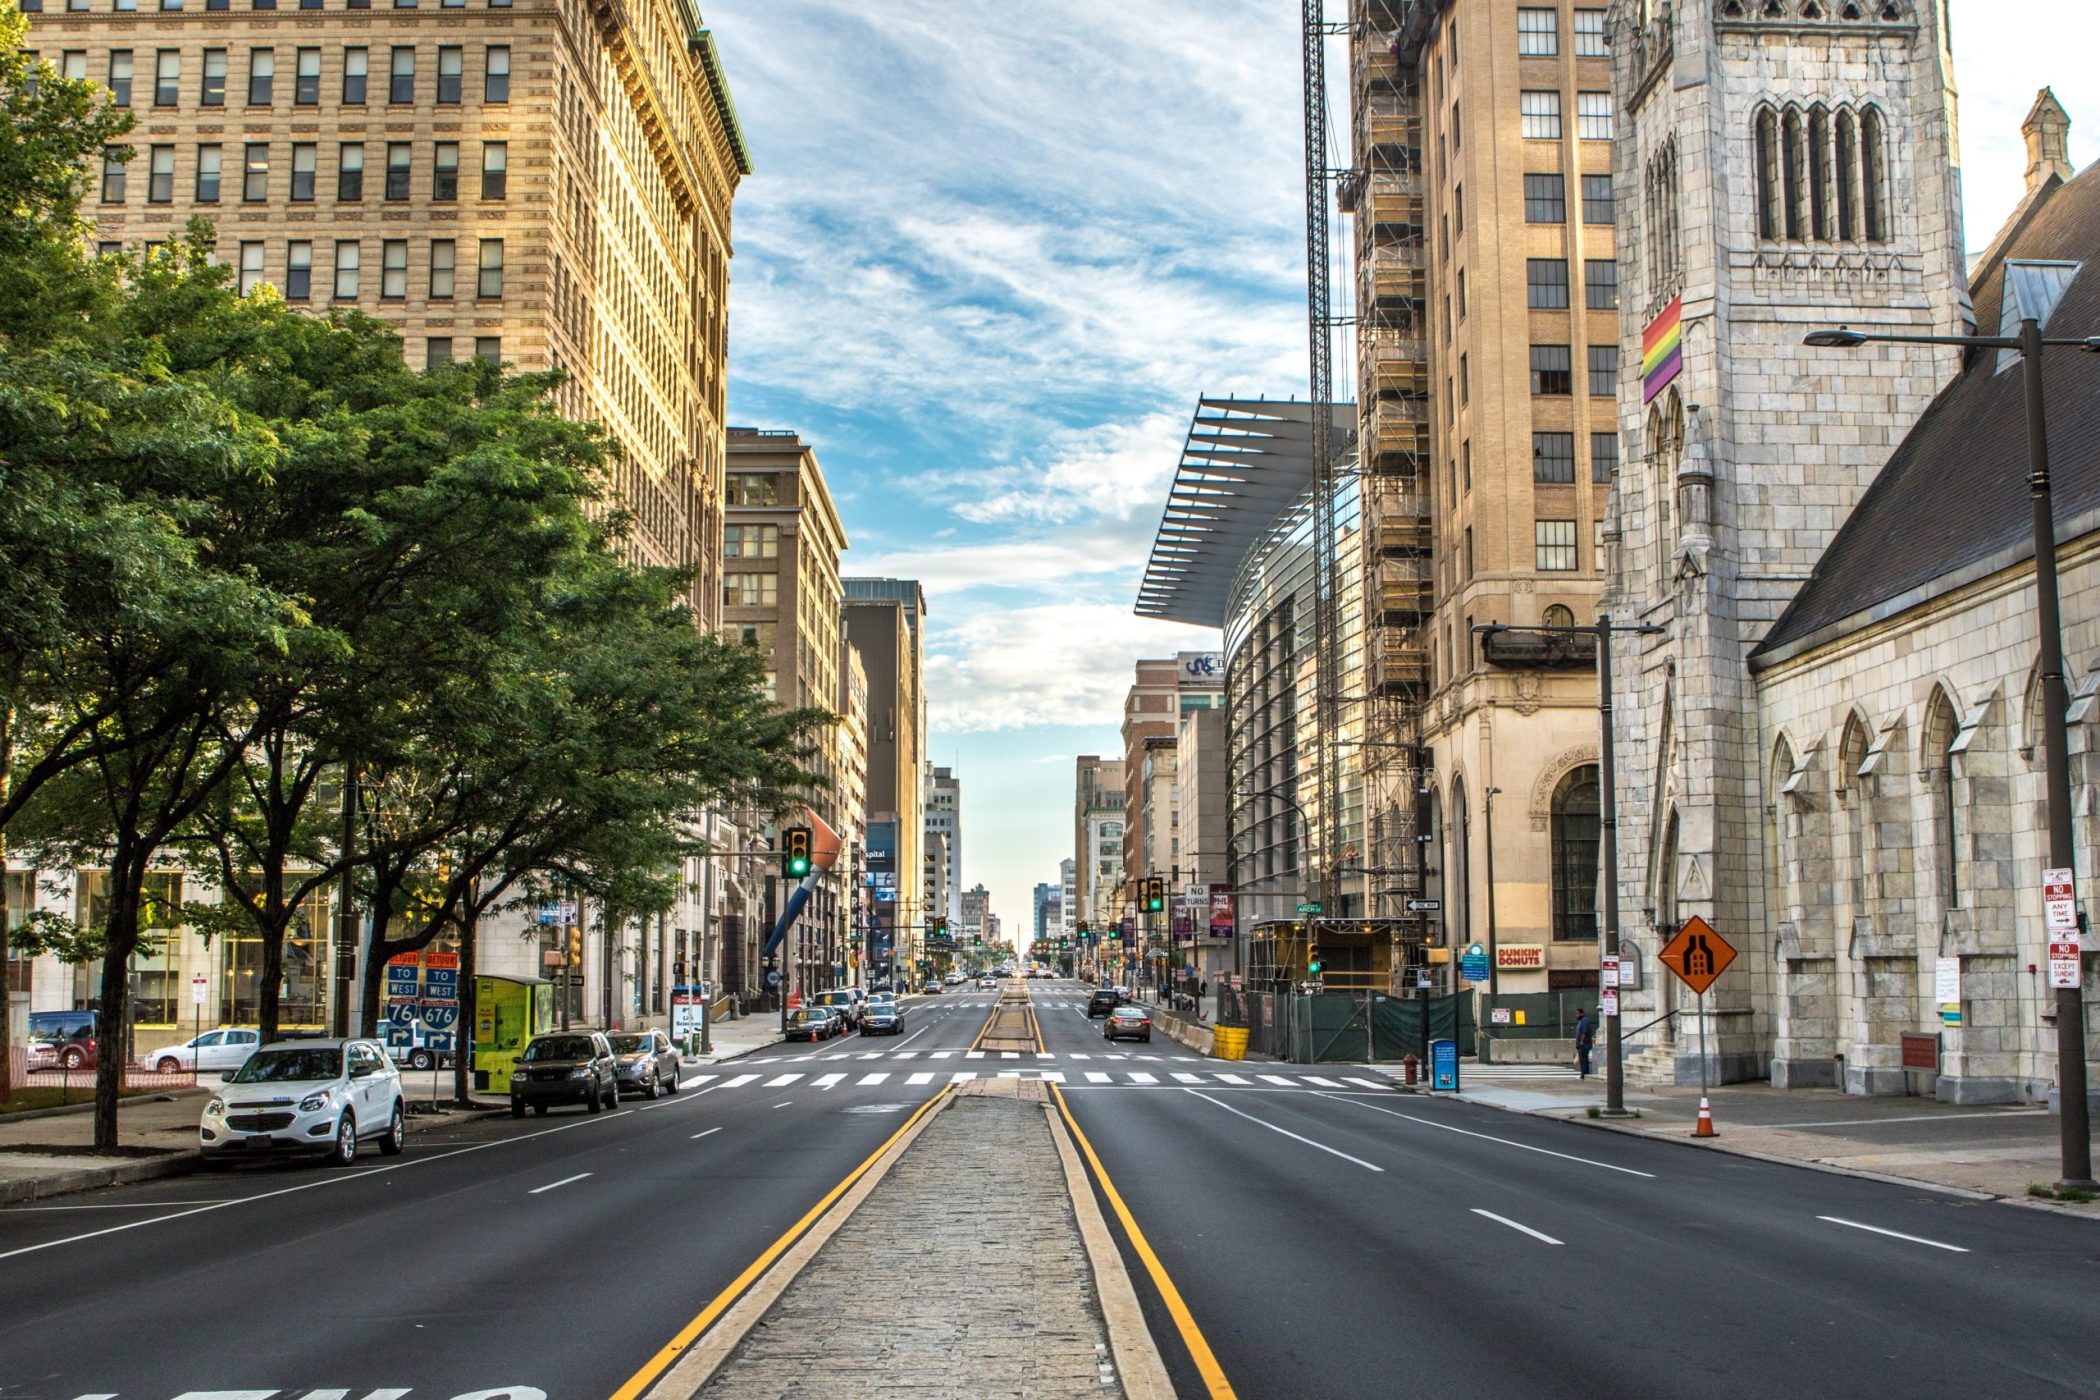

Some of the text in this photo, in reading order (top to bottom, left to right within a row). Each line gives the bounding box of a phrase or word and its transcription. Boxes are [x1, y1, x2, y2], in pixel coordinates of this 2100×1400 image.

[1191, 887, 1204, 896] NO
[2053, 885, 2064, 894] NO
[1498, 948, 1542, 957] DUNKIN'
[2058, 944, 2070, 953] NO
[427, 954, 456, 965] DETOUR
[1498, 957, 1540, 966] DONUTS
[396, 968, 411, 978] TO
[434, 971, 449, 981] TO
[391, 983, 415, 994] WEST
[429, 986, 453, 996] WEST
[389, 1004, 413, 1021] 76
[425, 1008, 453, 1023] 676
